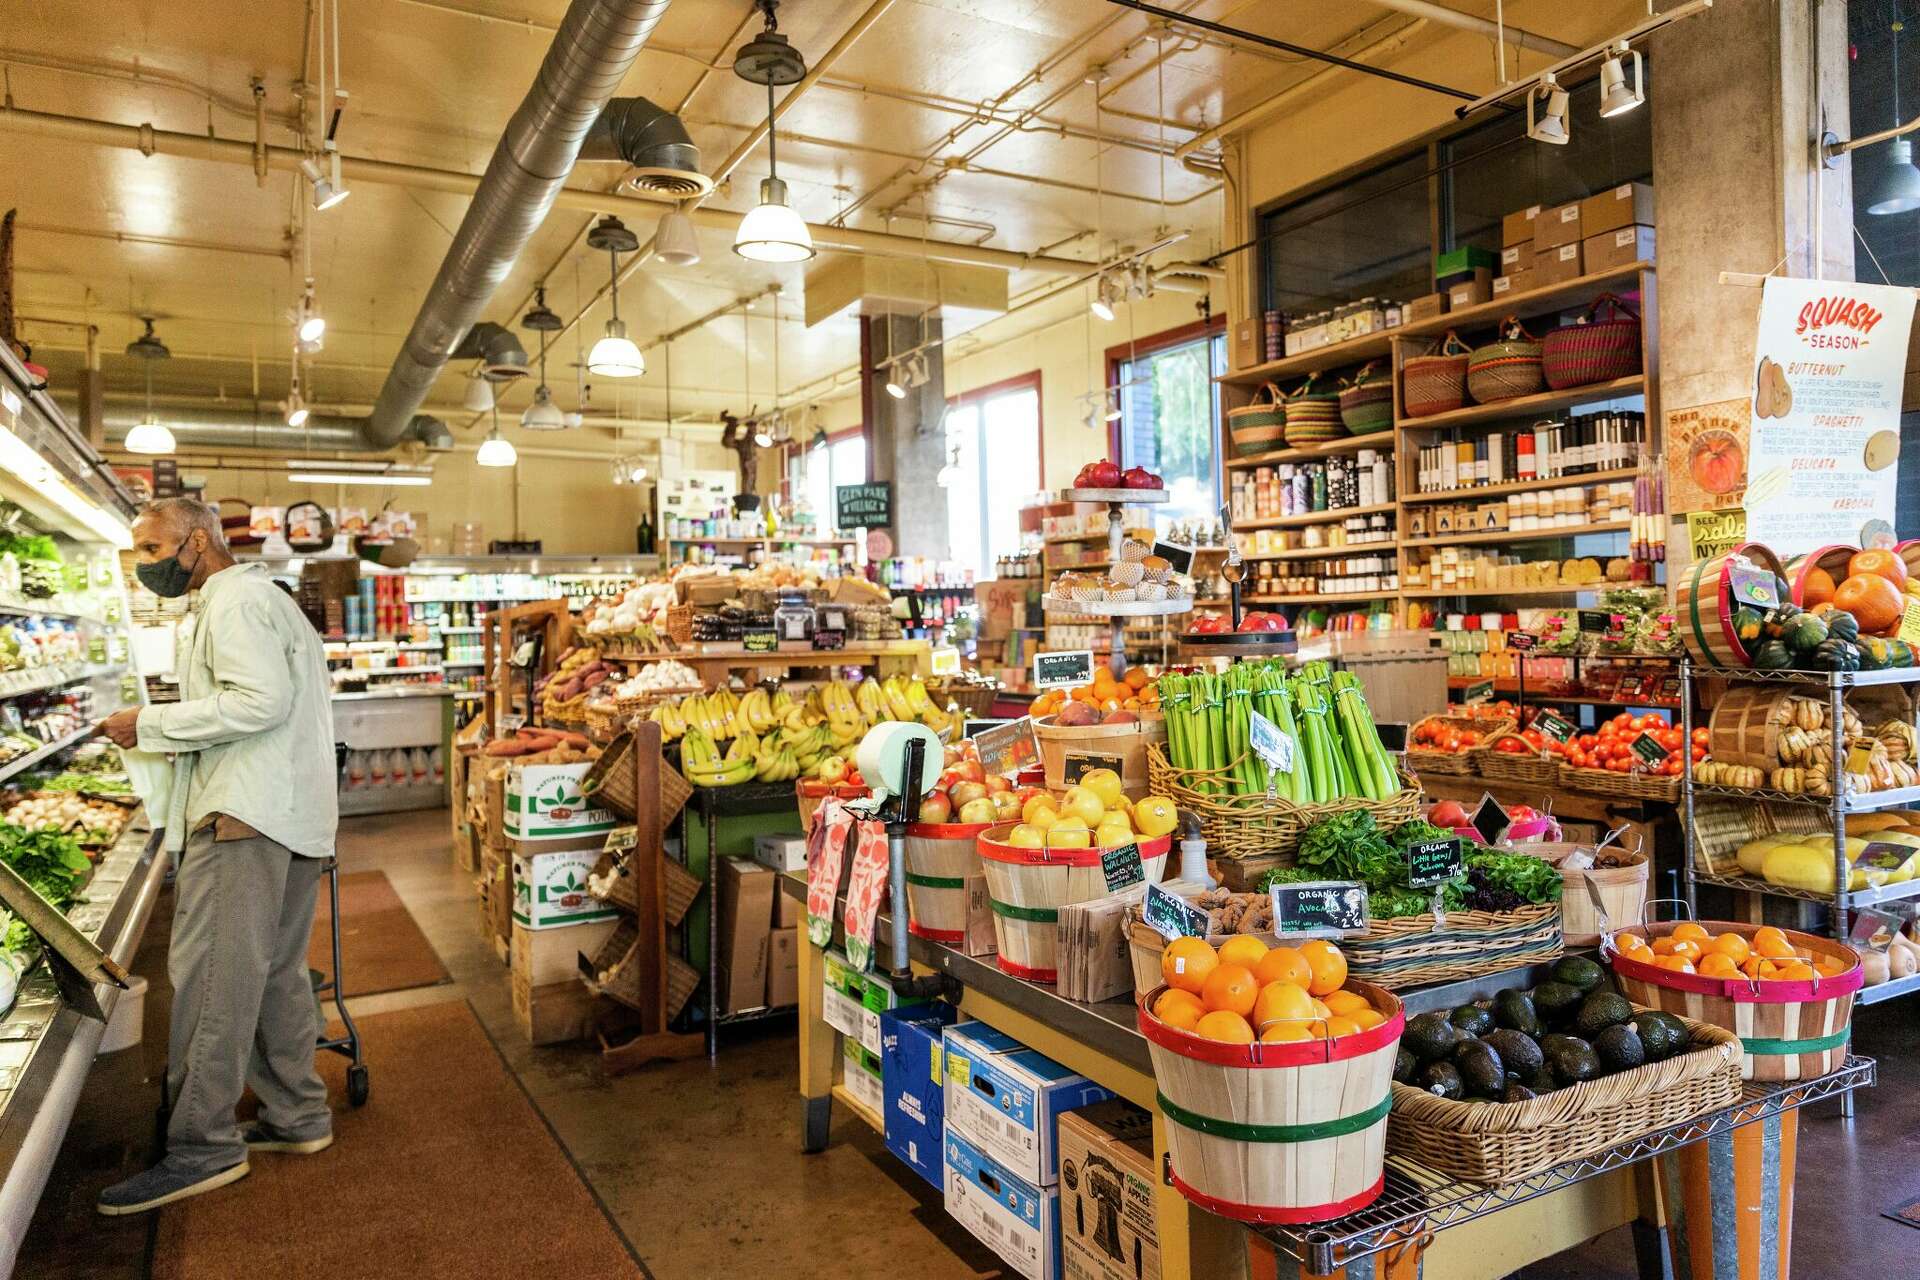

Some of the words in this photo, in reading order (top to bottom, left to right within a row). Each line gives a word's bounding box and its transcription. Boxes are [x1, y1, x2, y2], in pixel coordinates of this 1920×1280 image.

[1795, 296, 1882, 334] SQUASH
[1811, 334, 1859, 349] SEASON
[1788, 362, 1846, 376] BUTTERNUT
[1813, 415, 1864, 427] SPAGHETTI
[1792, 458, 1837, 470] DELICATA
[864, 486, 888, 501] PARK
[1696, 543, 1719, 558] NY
[1103, 844, 1136, 861] ORGANIC
[1104, 852, 1139, 871] WALNUTS
[1298, 889, 1340, 900] ORGANIC
[1150, 896, 1179, 919] NAVEL
[1159, 892, 1196, 918] ORGANIC
[1126, 1174, 1150, 1196] ORGANIC
[1128, 1187, 1150, 1208] APPLES
